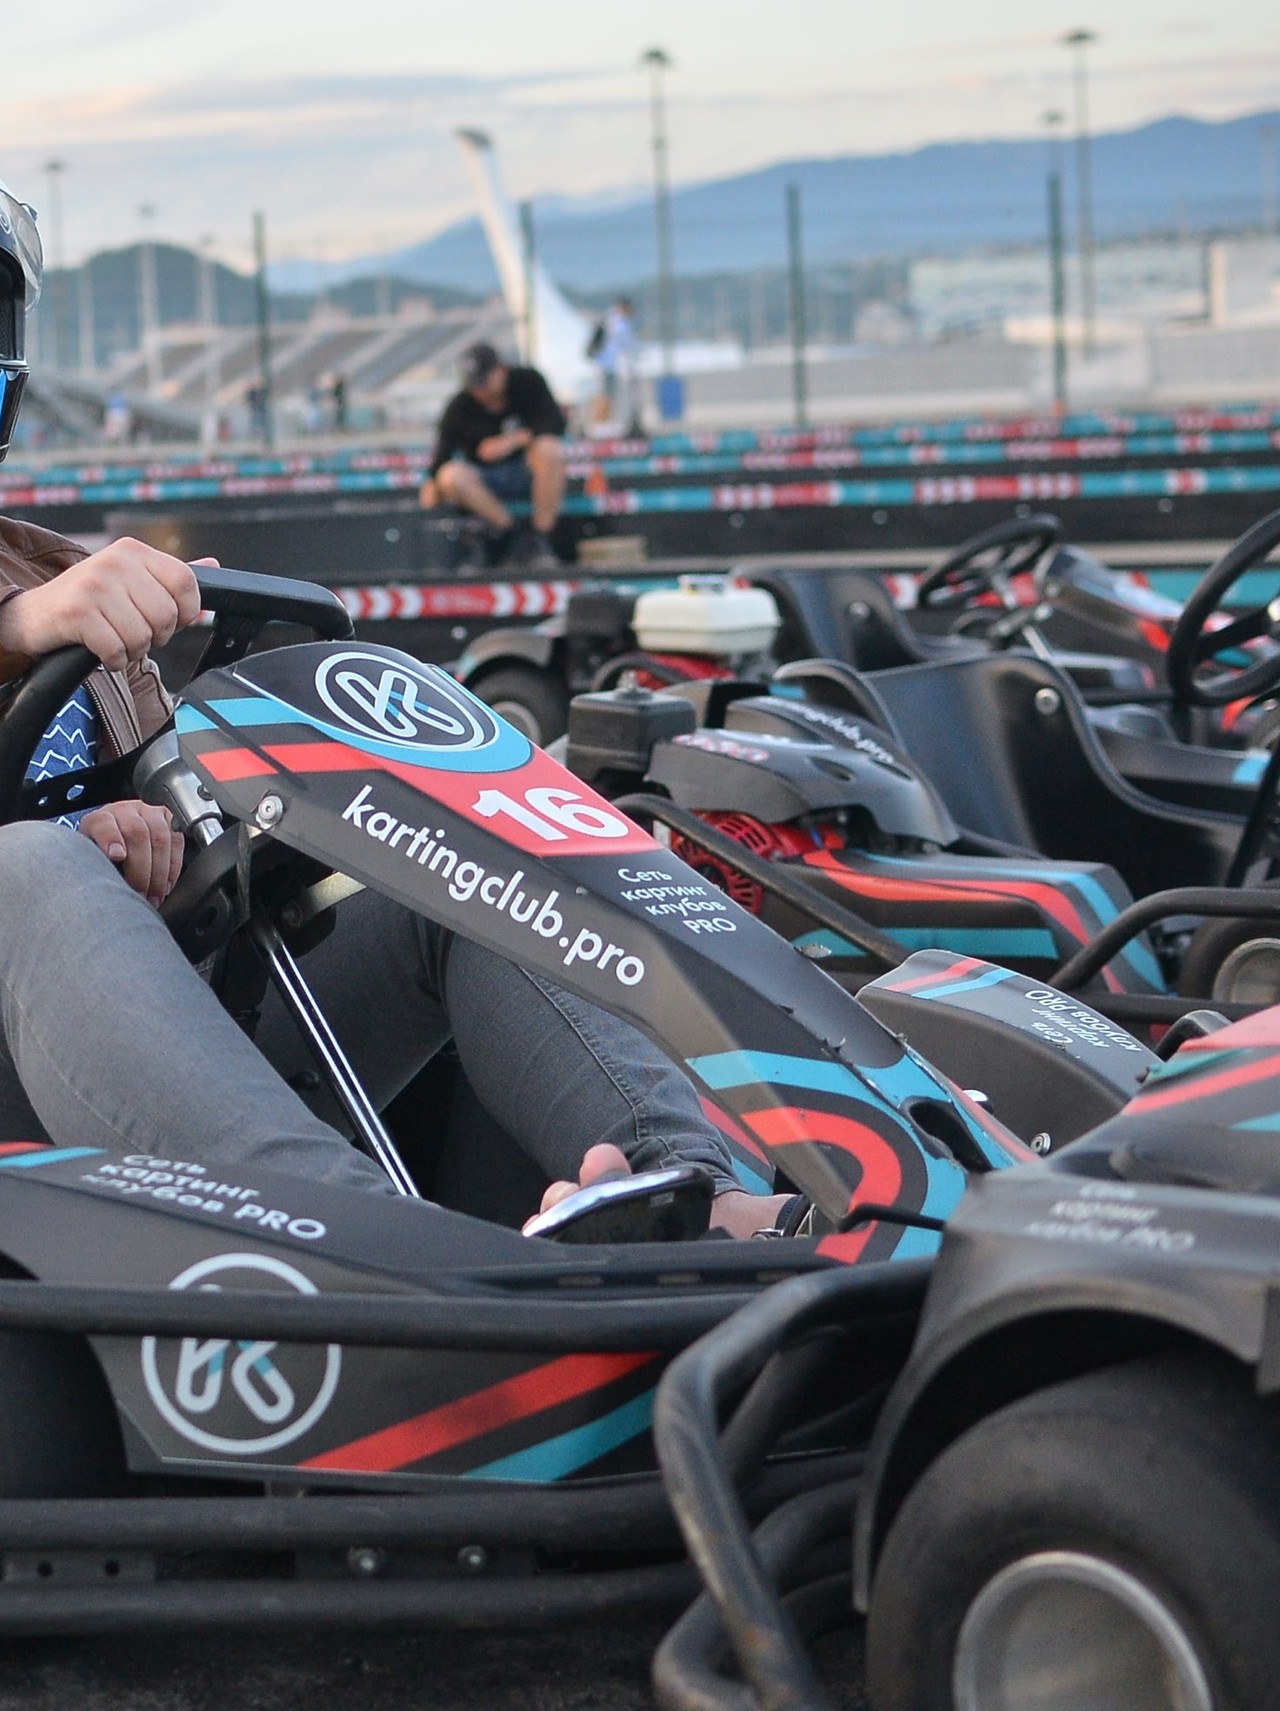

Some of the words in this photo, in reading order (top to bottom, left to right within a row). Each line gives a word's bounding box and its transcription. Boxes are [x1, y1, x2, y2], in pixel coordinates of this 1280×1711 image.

[471, 787, 629, 842] 16
[617, 867, 673, 883] Сеть
[341, 784, 646, 987] kartingclub.pro
[620, 885, 708, 902] картинг
[644, 898, 726, 918] клубов
[683, 918, 737, 935] PRO
[1025, 990, 1078, 1011] PRO
[233, 1203, 327, 1240] PRO
